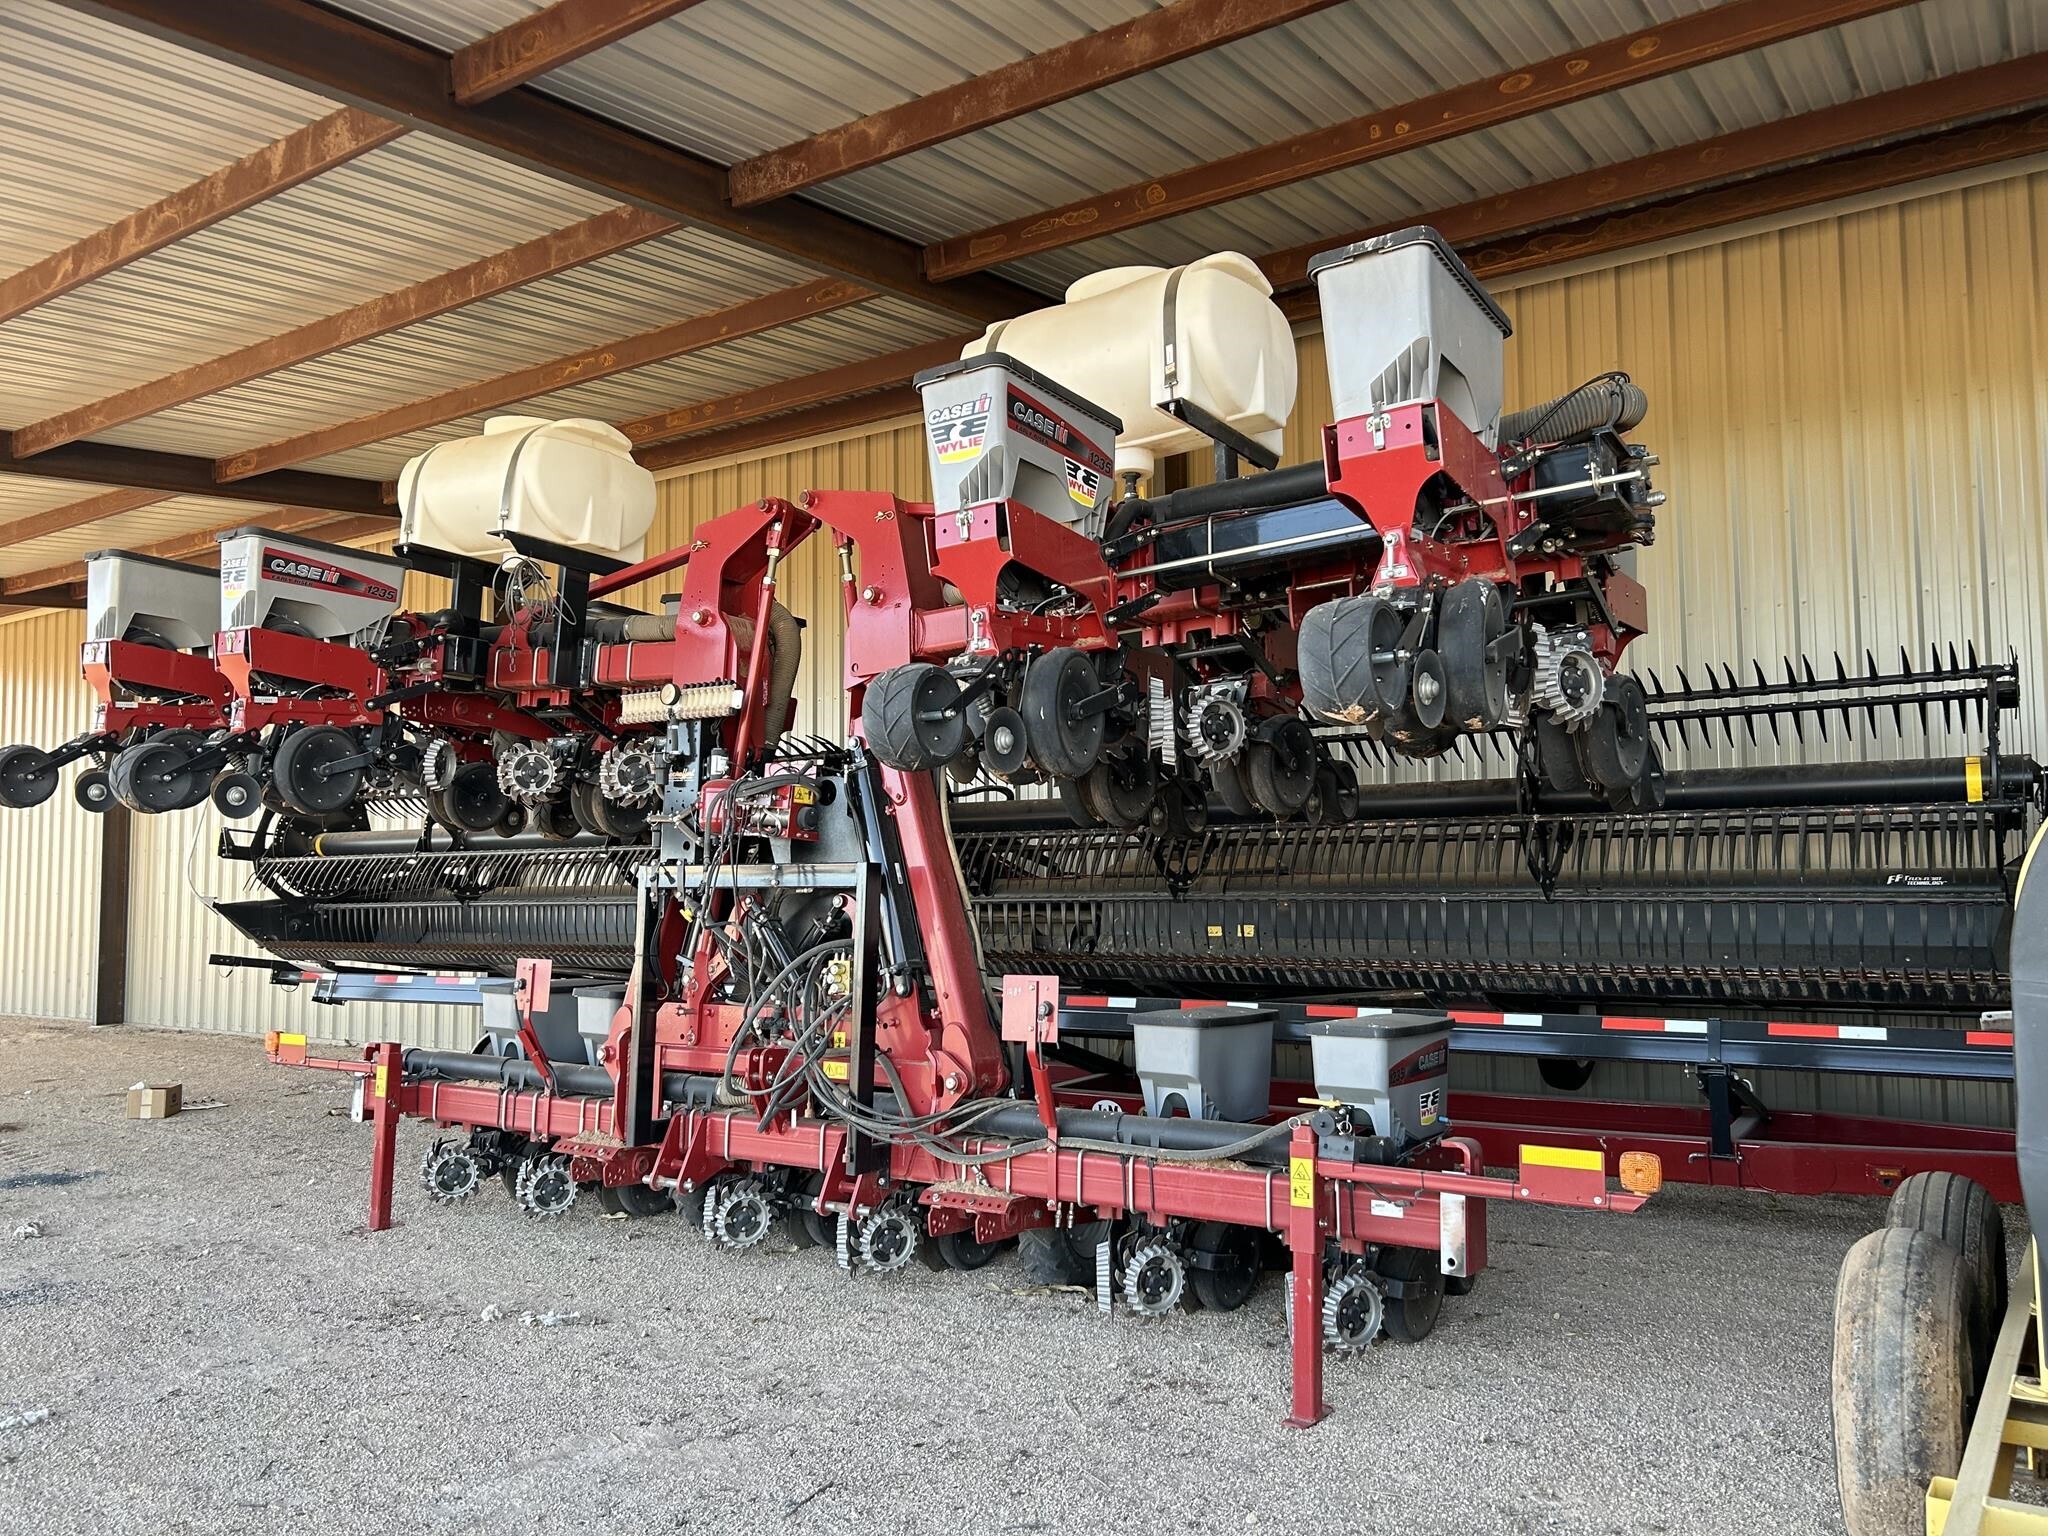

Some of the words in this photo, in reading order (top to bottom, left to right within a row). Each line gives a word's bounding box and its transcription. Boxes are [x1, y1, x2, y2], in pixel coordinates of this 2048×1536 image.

[928, 401, 974, 425] CASE
[1014, 402, 1055, 437] CASE
[937, 436, 983, 454] WYLIE
[1090, 451, 1113, 474] 1235
[1069, 478, 1096, 499] WYLIE
[271, 559, 322, 580] CASE
[367, 585, 396, 600] 1235
[1419, 1050, 1439, 1071] CASE
[1421, 1105, 1438, 1118] WYLIE
